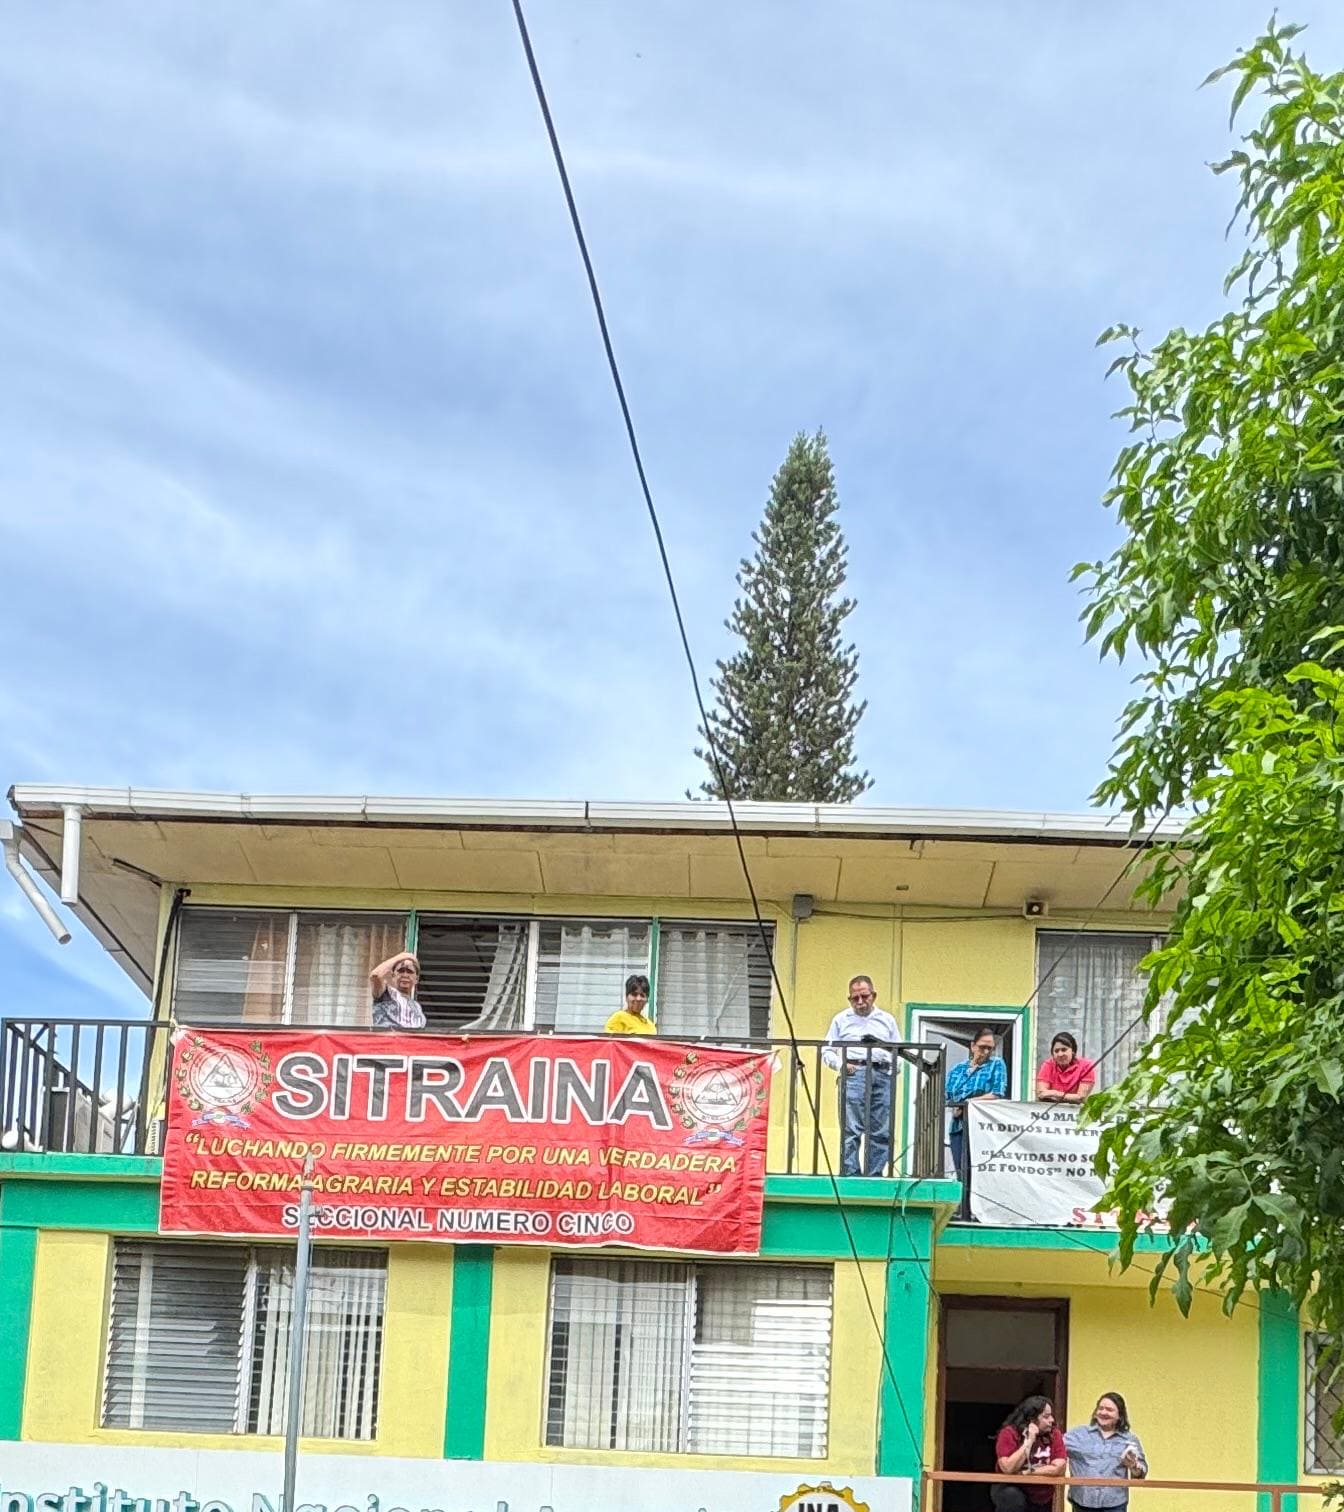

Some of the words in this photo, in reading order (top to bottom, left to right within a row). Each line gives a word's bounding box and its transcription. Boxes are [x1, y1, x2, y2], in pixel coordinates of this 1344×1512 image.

[271, 1053, 673, 1130] SITRAINA
[1030, 1112, 1051, 1121] NO
[978, 1122, 994, 1132] YA
[1046, 1126, 1062, 1135] LA
[185, 1133, 327, 1160] “LUCHANDO
[331, 1142, 481, 1164] FIRMEMENTE
[486, 1146, 536, 1166] POR
[542, 1148, 591, 1167] UNA
[599, 1147, 737, 1173] VERDADERA
[1015, 1152, 1054, 1163] VIDAS
[1057, 1153, 1077, 1163] NO
[977, 1163, 996, 1173] DE
[1066, 1168, 1086, 1177] NO
[191, 1169, 304, 1192] REFORMA
[309, 1175, 413, 1195] AGRARIA
[420, 1177, 437, 1197] Y
[441, 1178, 592, 1200] ESTABILIDAD
[598, 1181, 722, 1206] LABORAL”
[436, 1208, 551, 1233] NUMERO
[558, 1211, 634, 1236] CINCO
